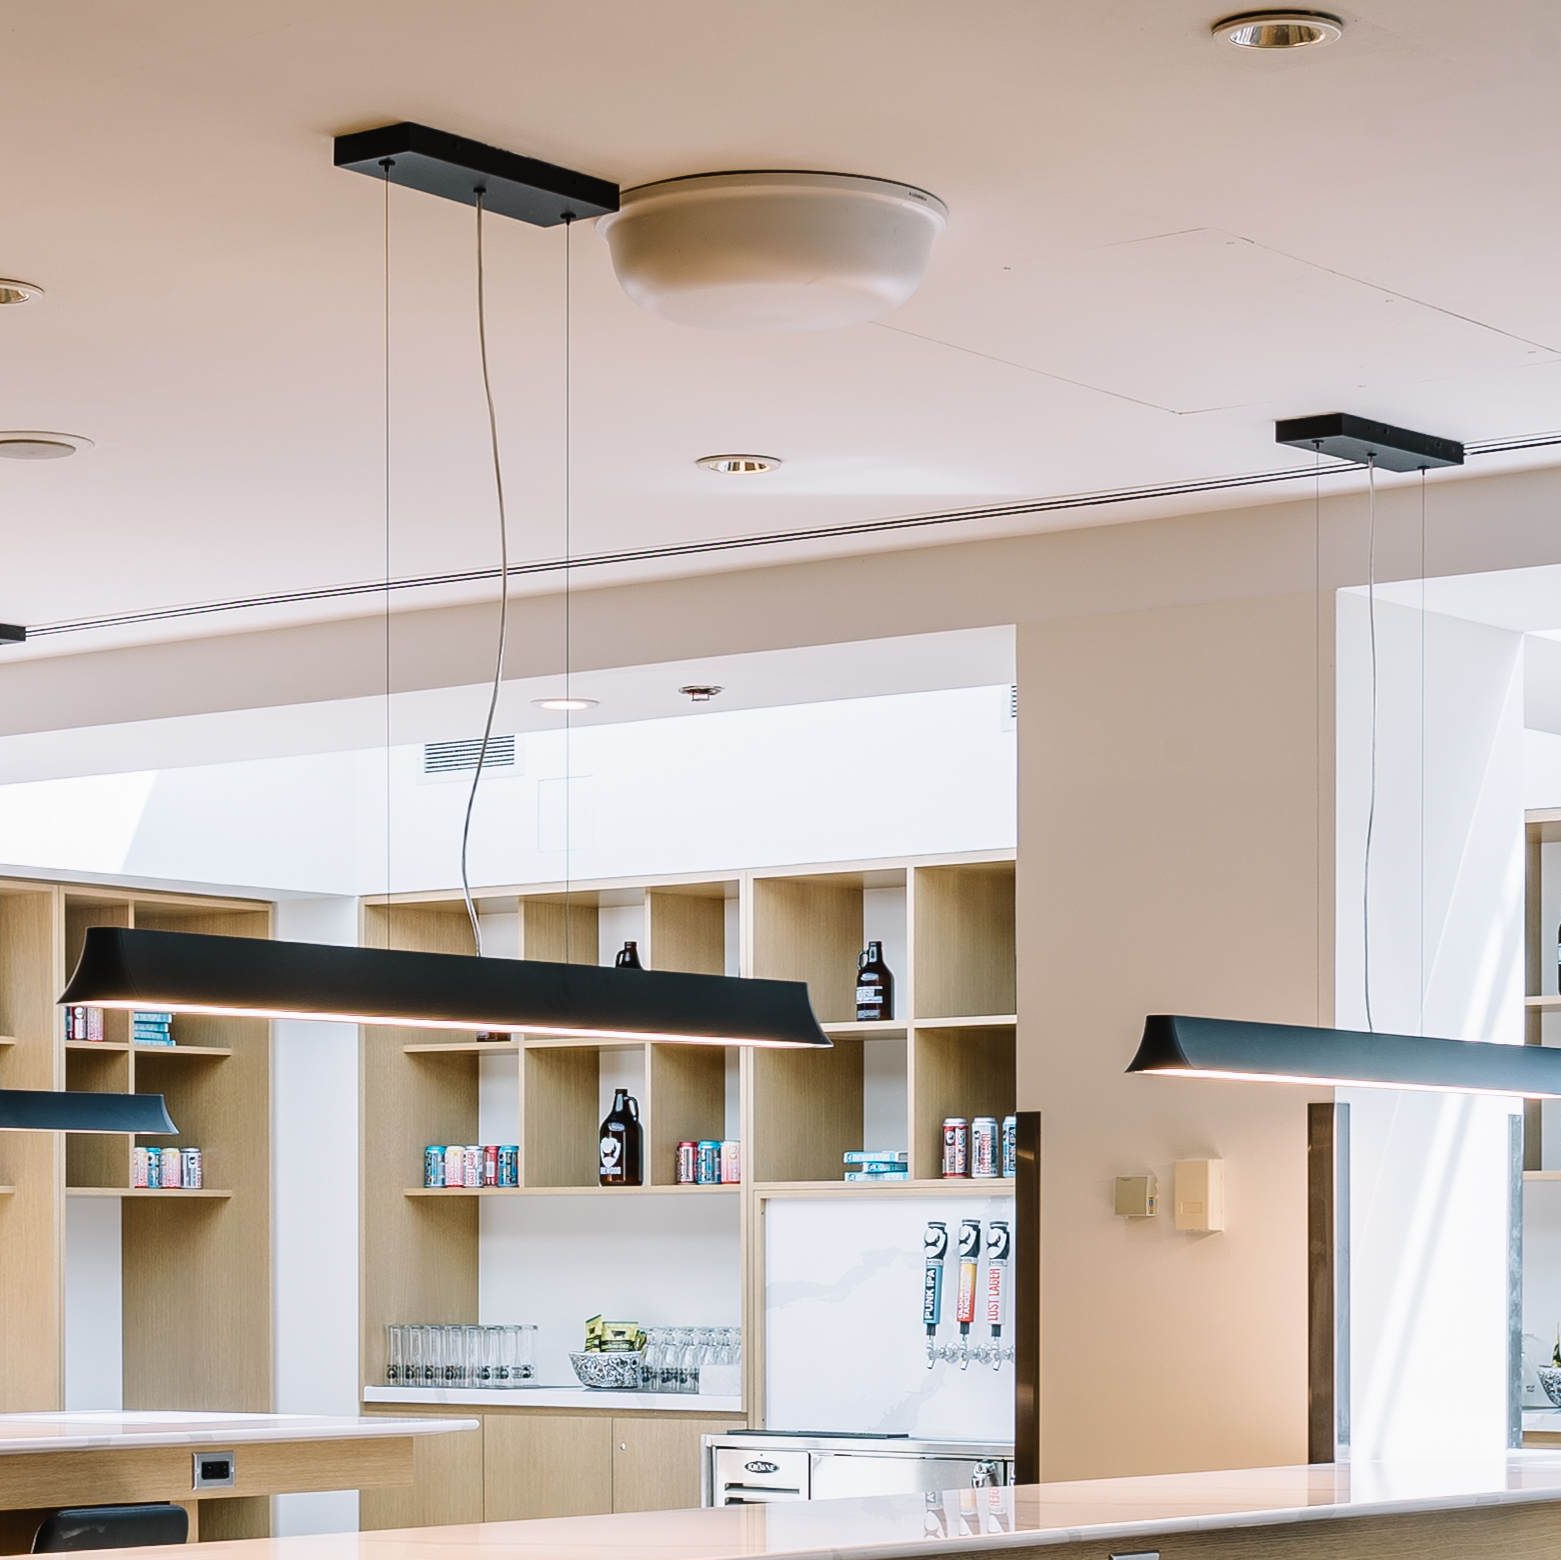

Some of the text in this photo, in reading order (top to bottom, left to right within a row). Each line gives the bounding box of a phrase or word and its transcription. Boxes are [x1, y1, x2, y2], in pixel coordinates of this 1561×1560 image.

[924, 1269, 936, 1319] PUNK IPA
[987, 1300, 1000, 1321] LOST
